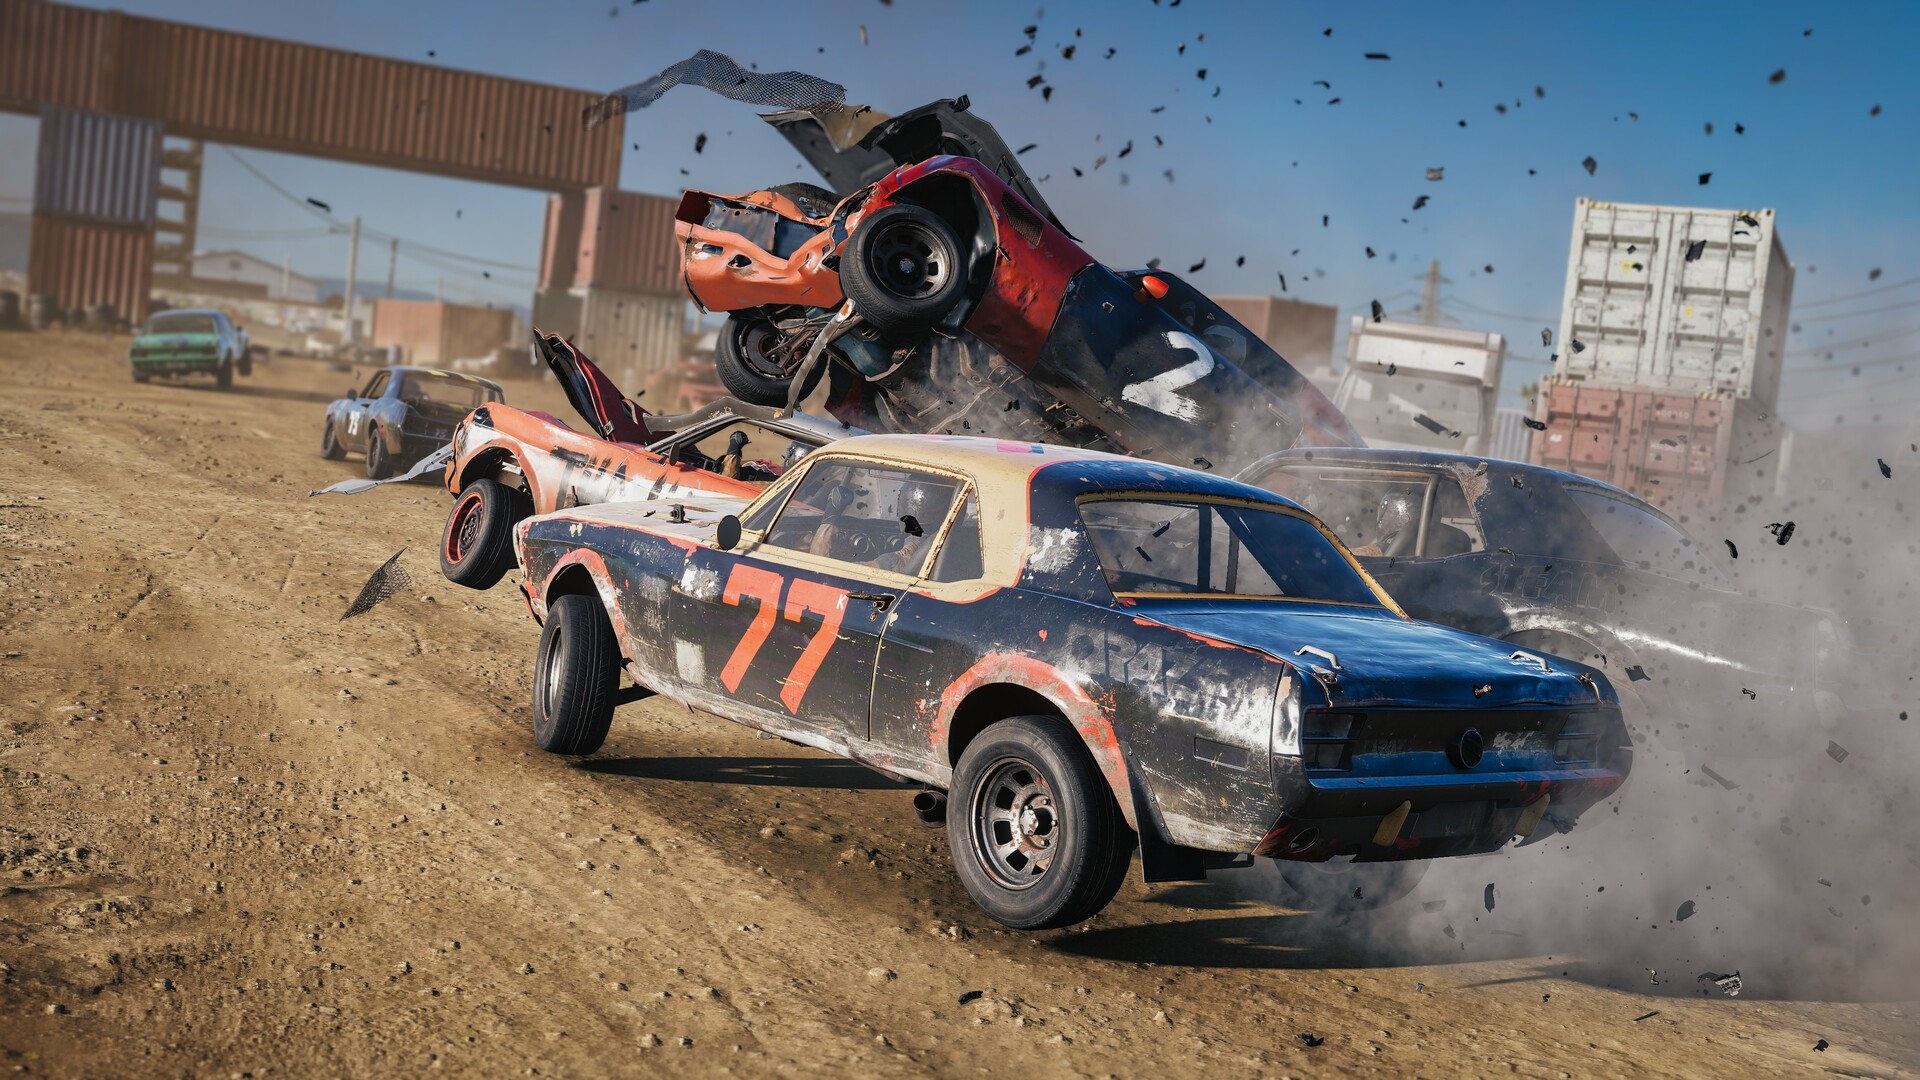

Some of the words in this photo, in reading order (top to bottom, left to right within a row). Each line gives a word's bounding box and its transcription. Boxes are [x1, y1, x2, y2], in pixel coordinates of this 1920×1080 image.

[1121, 331, 1214, 425] 2
[720, 563, 850, 715] 77
[836, 594, 847, 610] K
